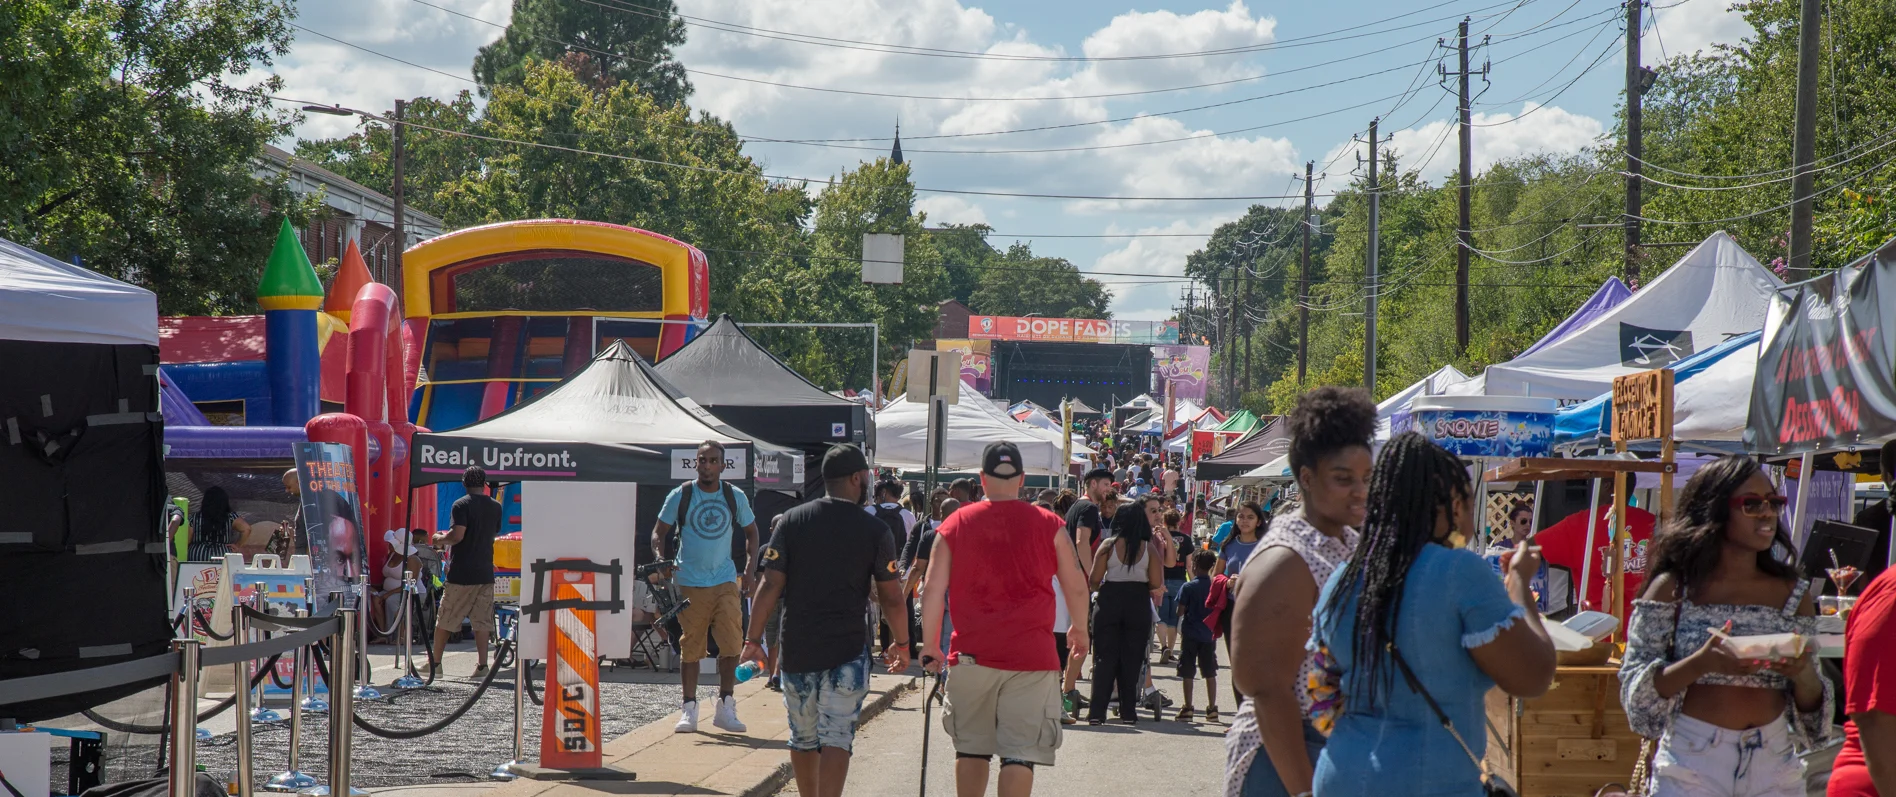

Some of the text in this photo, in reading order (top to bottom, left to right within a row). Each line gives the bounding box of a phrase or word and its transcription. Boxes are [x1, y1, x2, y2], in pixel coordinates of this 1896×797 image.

[1017, 319, 1132, 337] DOPE FADES
[1435, 418, 1499, 439] SNOWIE
[420, 444, 577, 470] Real. Upfront.
[309, 480, 324, 492] OF
